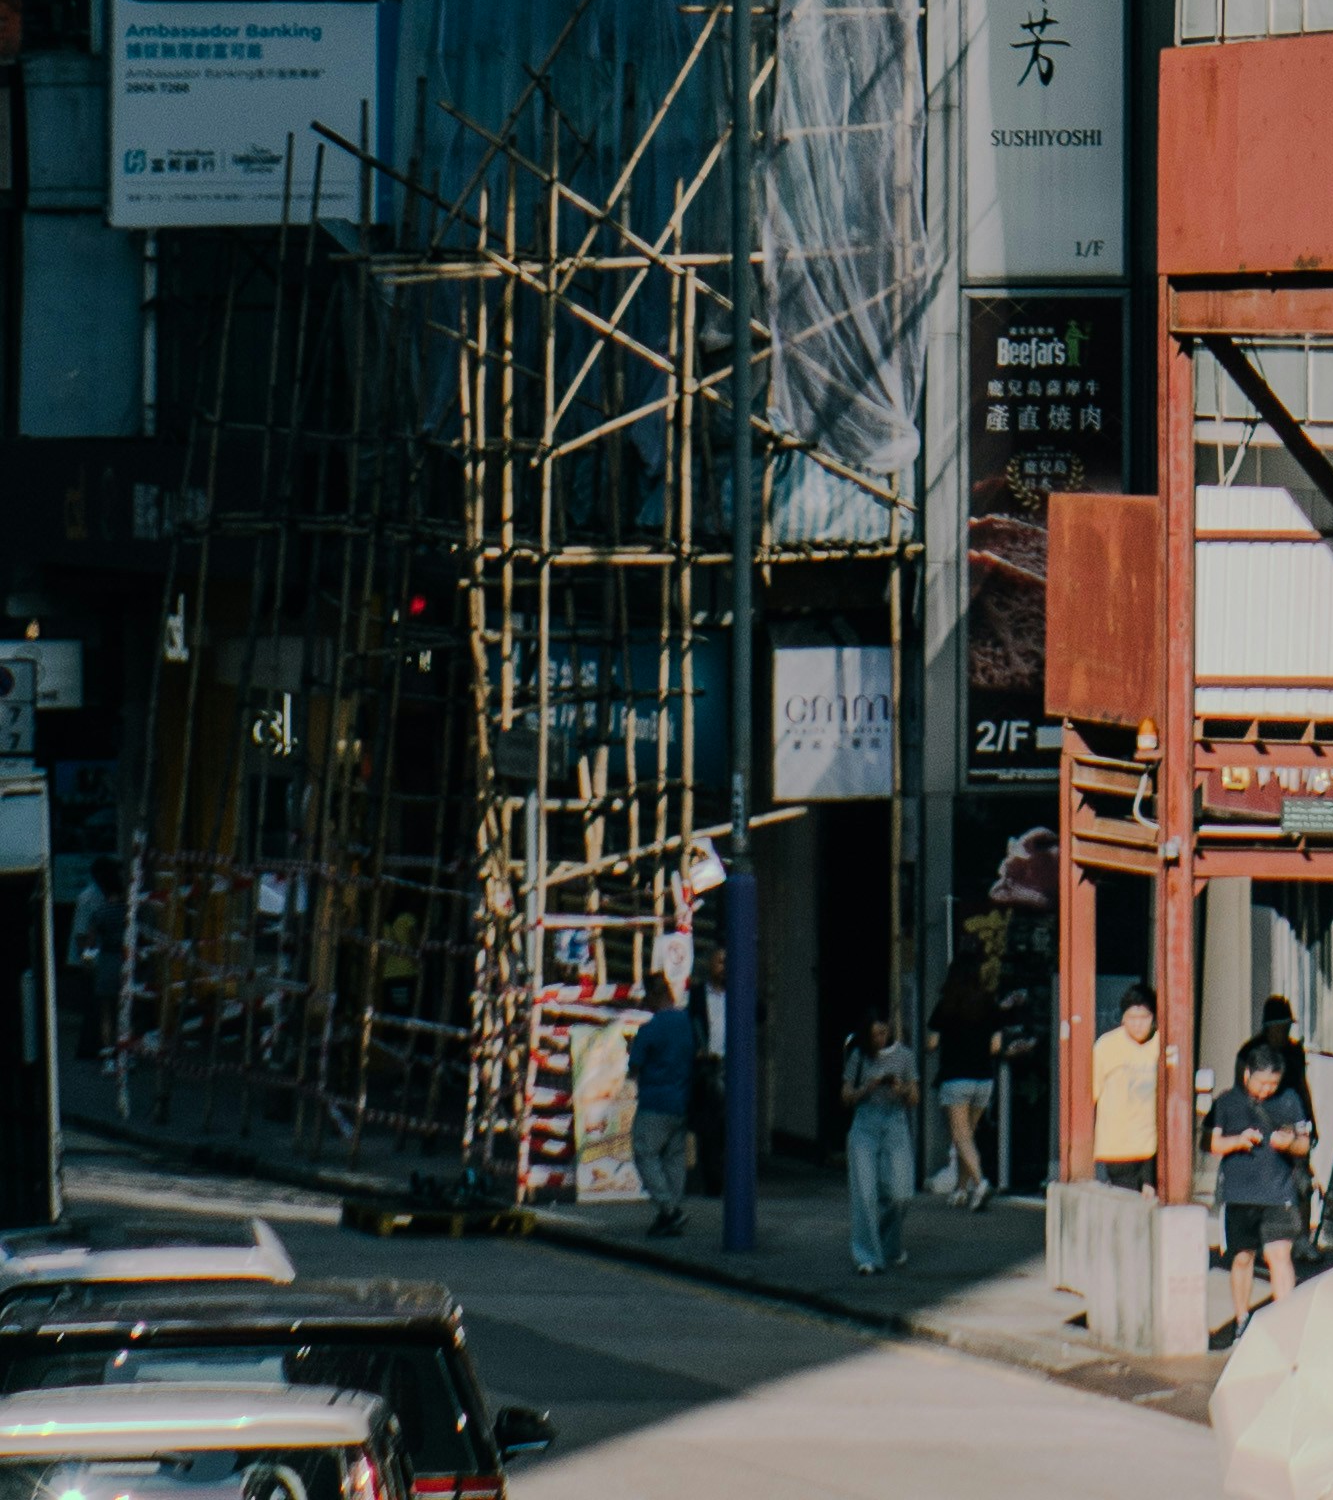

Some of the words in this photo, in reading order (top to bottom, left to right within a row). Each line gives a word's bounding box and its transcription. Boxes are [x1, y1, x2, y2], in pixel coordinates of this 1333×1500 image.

[125, 23, 240, 39] Ambassador
[245, 23, 322, 42] Banking
[990, 128, 1103, 148] SUSHIYOSHI
[1073, 240, 1105, 258] 1/F
[996, 337, 1066, 370] Beefar's
[975, 719, 1031, 753] 2/F
